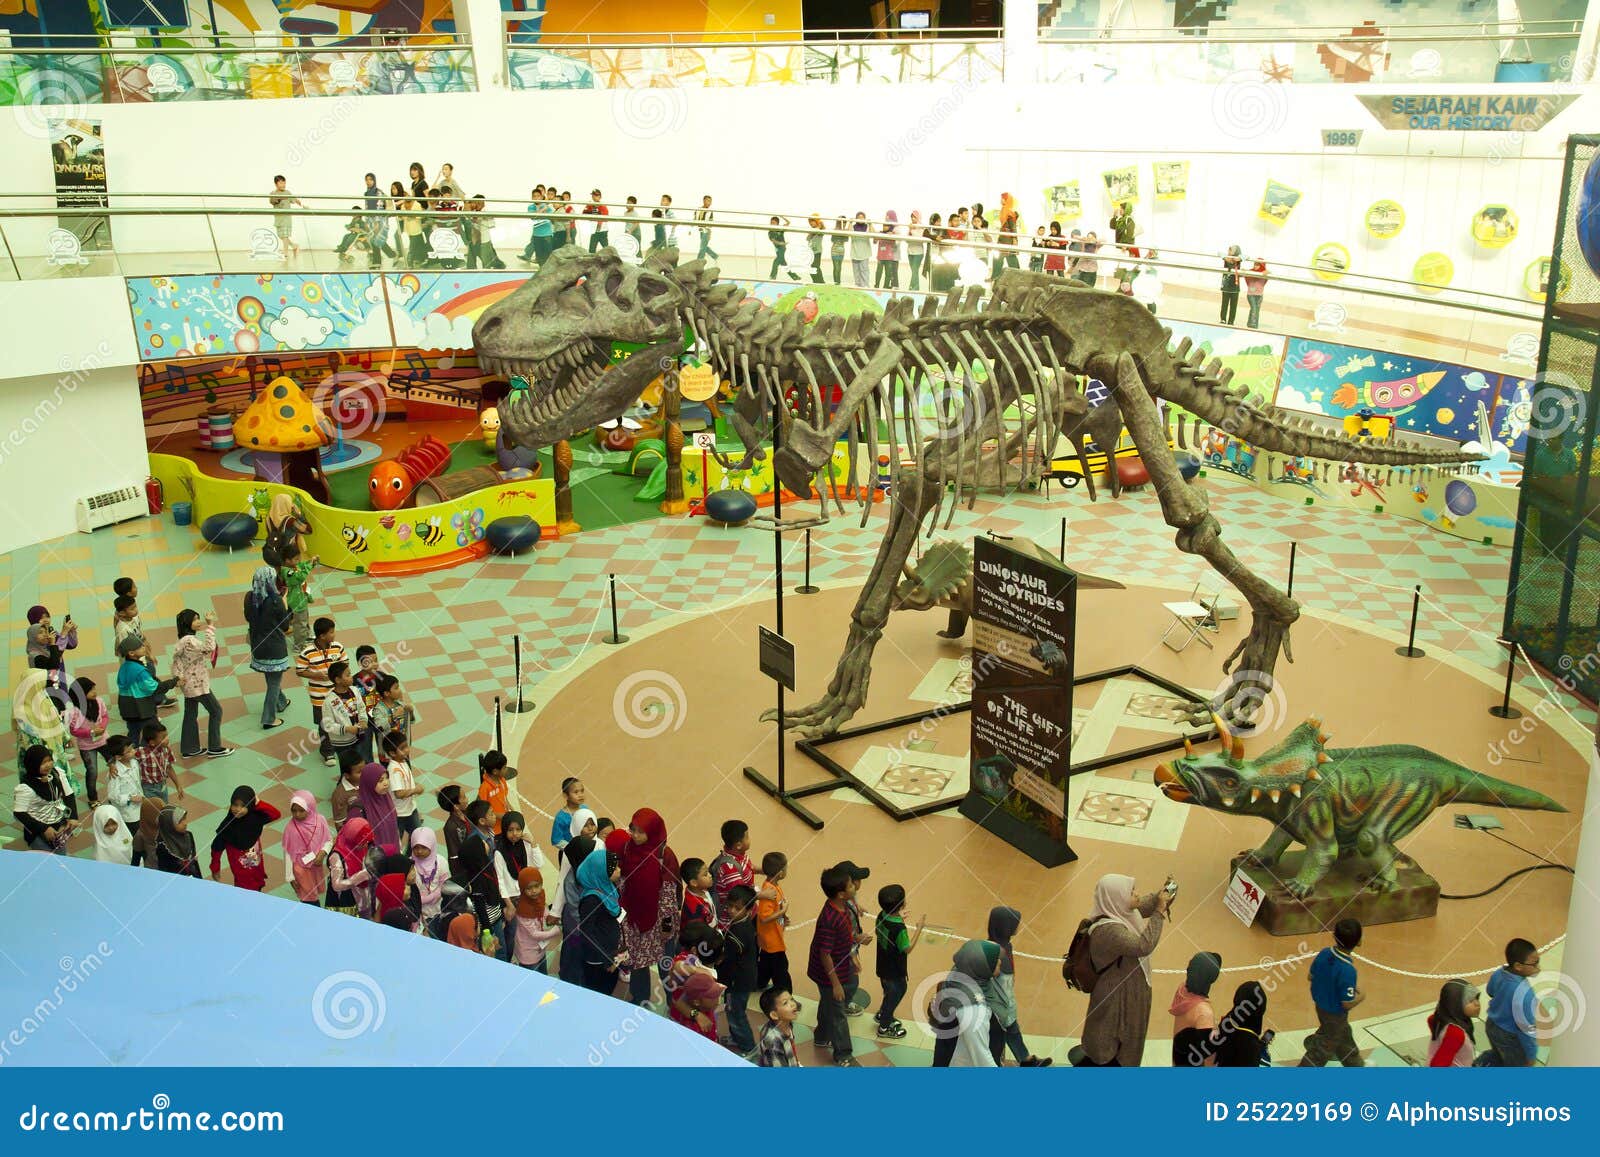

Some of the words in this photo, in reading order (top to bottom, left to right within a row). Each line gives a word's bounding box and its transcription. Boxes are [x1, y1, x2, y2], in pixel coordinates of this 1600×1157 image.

[1391, 97, 1481, 115] SEJARAH
[1487, 97, 1537, 115] KAMI
[1409, 115, 1441, 129] OUR
[1448, 115, 1515, 130] HISTORY
[1326, 132, 1356, 146] 1996
[980, 560, 1048, 595] DINOSAUR
[994, 602, 1002, 610] TO
[999, 581, 1065, 612] JOYRIDES
[987, 700, 1004, 718] OF
[1007, 712, 1034, 737] LIFE
[1003, 694, 1028, 719] THE
[1032, 713, 1063, 738] GIFT
